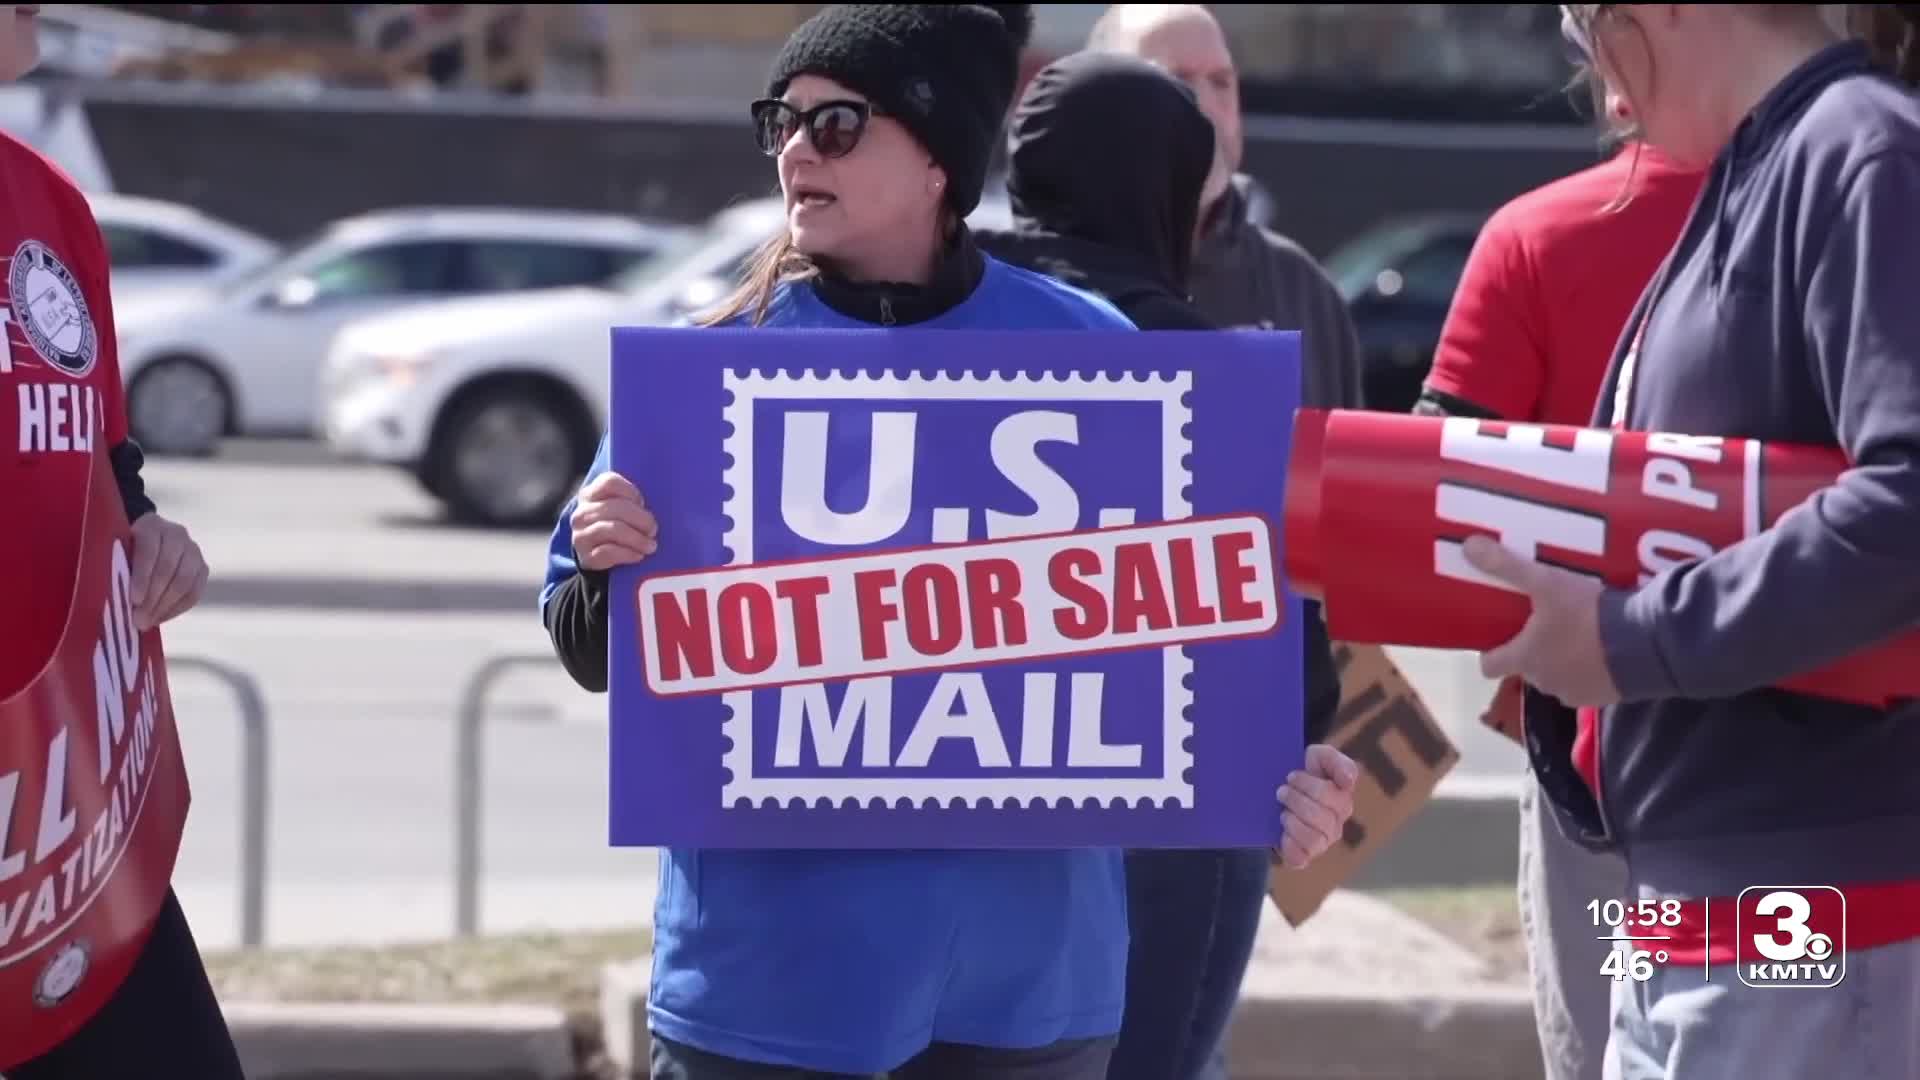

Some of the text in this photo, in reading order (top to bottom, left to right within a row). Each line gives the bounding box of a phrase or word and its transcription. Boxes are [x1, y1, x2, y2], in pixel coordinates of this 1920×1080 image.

[781, 409, 1135, 546] U.S.
[92, 537, 140, 786] NO
[652, 530, 1265, 682] NOT FOR SALE
[773, 671, 1143, 769] MAIL
